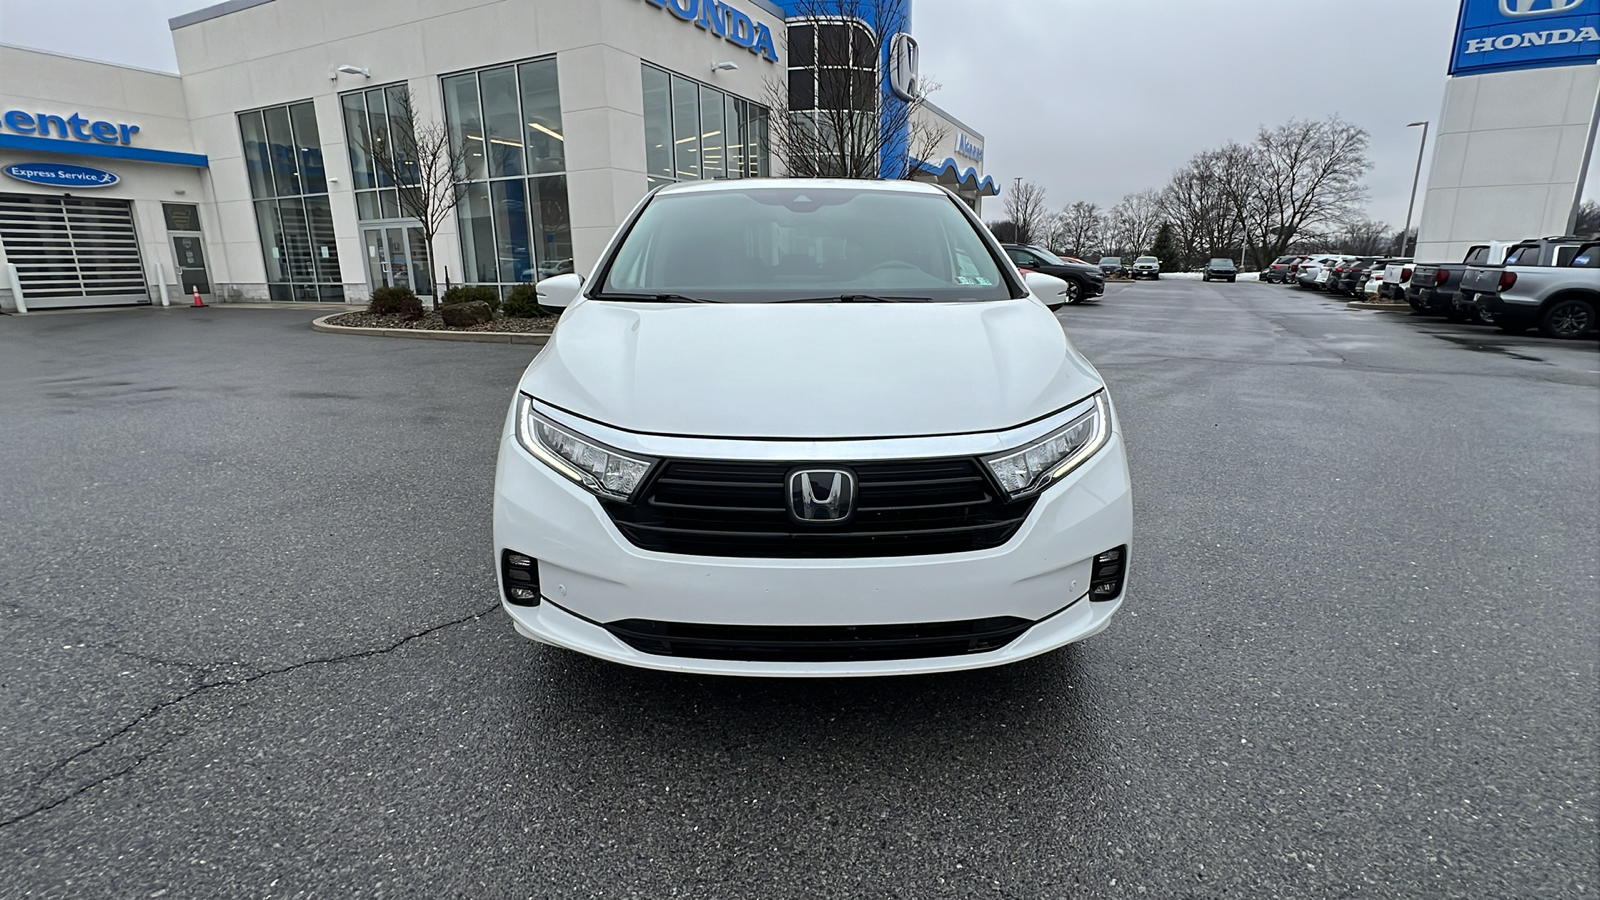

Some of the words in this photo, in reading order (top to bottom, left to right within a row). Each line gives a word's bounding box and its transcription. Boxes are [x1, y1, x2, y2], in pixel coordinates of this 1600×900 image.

[645, 0, 779, 63] ONDA
[1464, 26, 1600, 54] HONDA
[0, 109, 140, 145] enter
[11, 167, 56, 179] Express
[57, 170, 98, 181] Service
